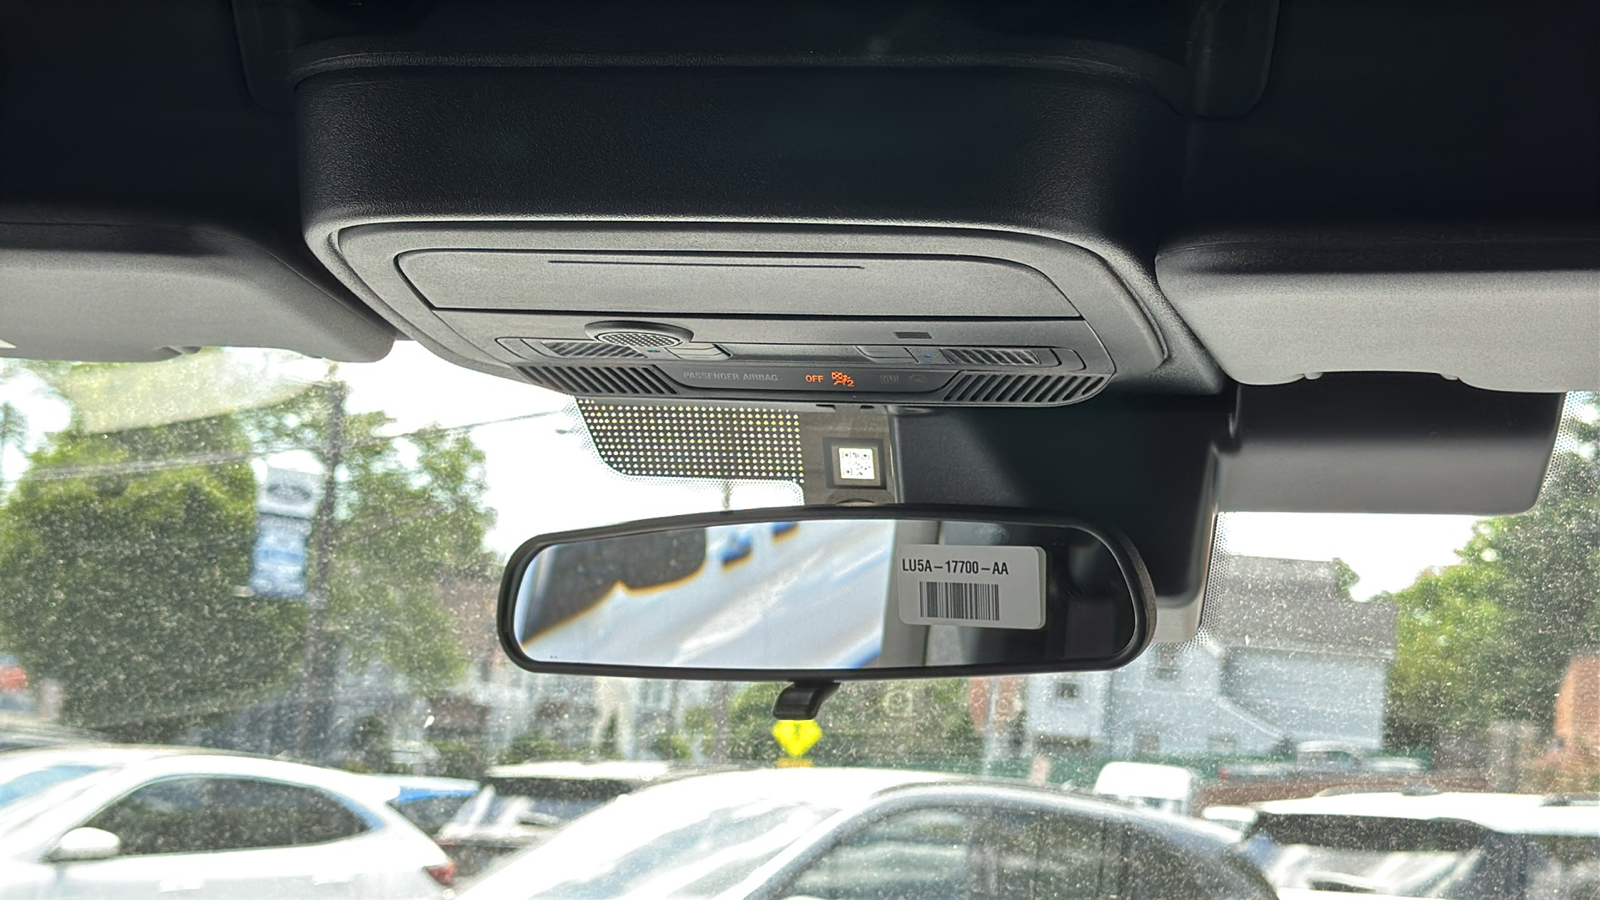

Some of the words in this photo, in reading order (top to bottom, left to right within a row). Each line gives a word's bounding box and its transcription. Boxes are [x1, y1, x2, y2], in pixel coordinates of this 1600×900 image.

[683, 371, 740, 381] PASSENGER
[742, 373, 779, 382] AIRBAG
[805, 374, 824, 383] OFF
